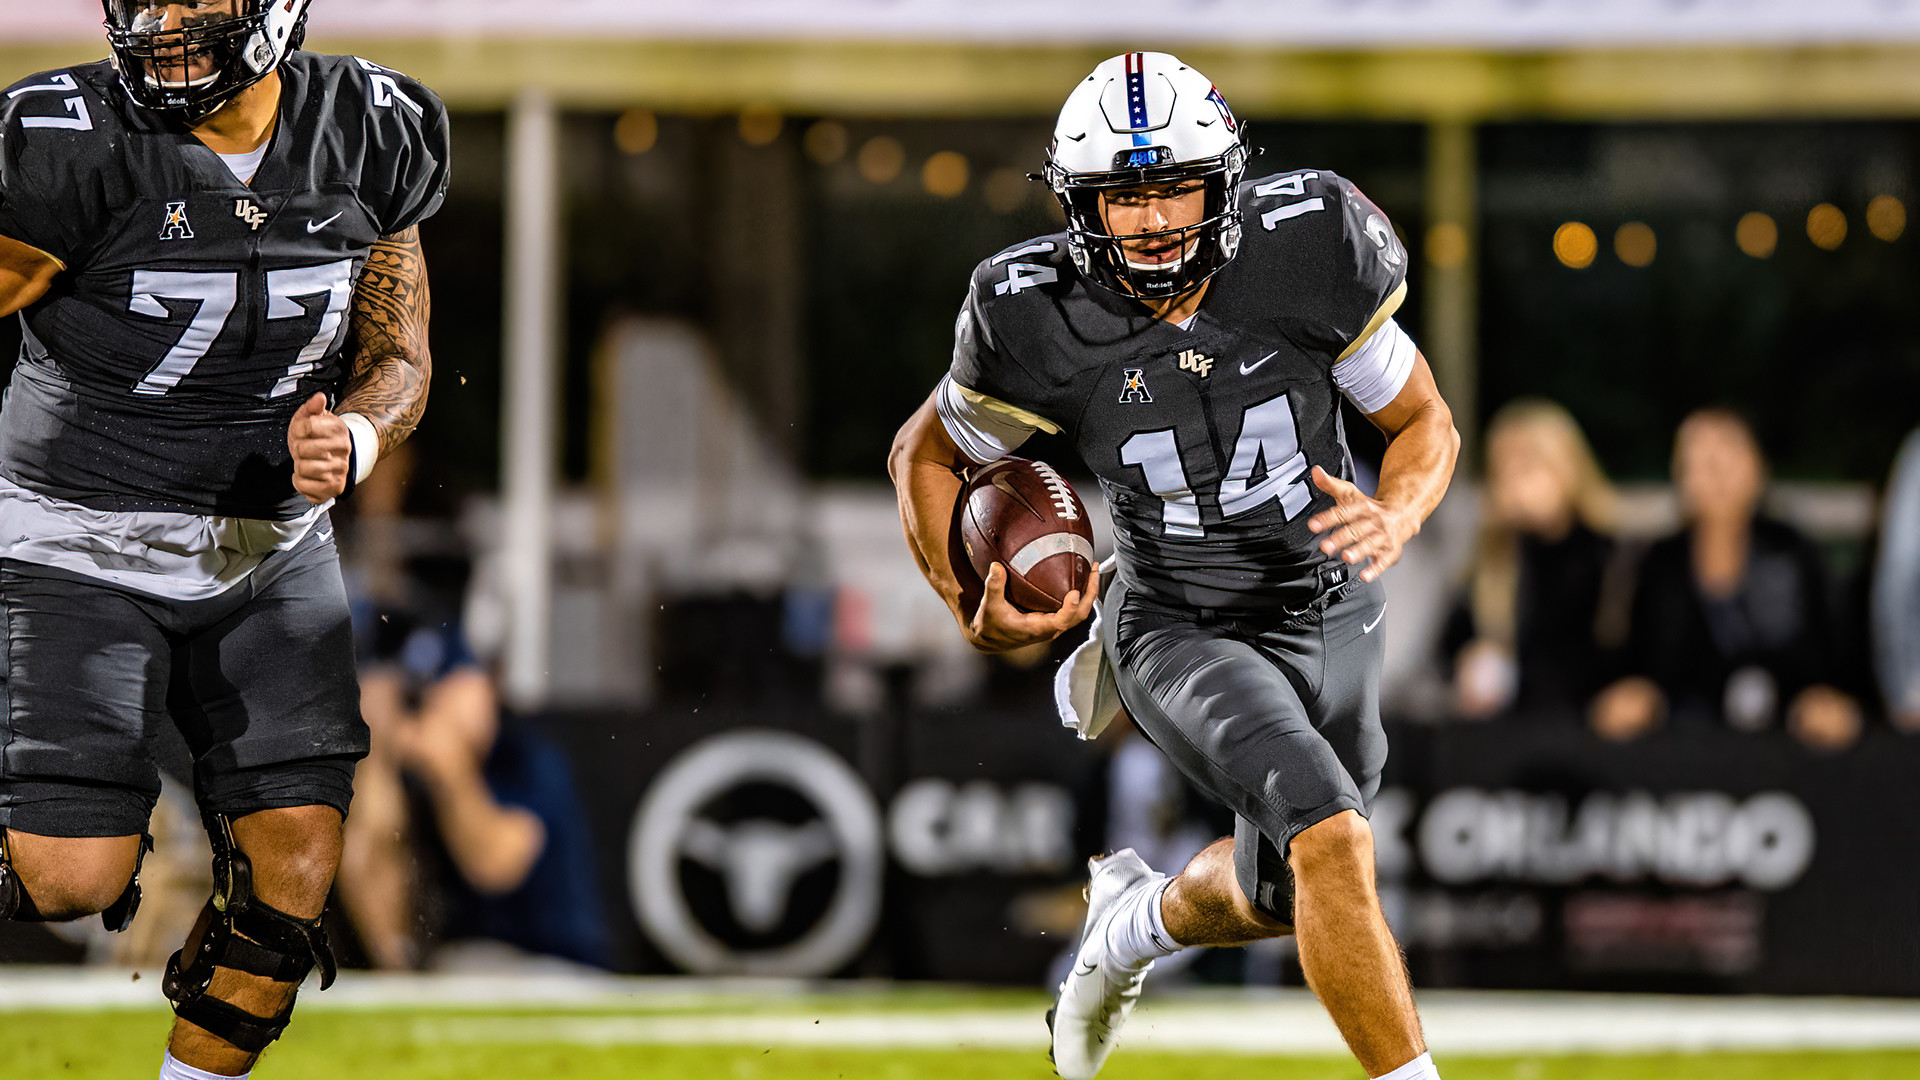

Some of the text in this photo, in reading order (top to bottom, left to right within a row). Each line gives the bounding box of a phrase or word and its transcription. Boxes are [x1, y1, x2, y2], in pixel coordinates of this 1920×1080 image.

[6, 73, 93, 131] 77
[159, 202, 194, 240] A
[235, 199, 268, 230] UCF
[1255, 172, 1325, 231] 14
[991, 242, 1058, 296] 14
[129, 259, 353, 397] 77
[1119, 369, 1153, 403] A
[1178, 349, 1214, 378] UCF
[1120, 394, 1313, 538] 14
[1330, 570, 1342, 584] M
[1419, 786, 1816, 890] ORLANDO
